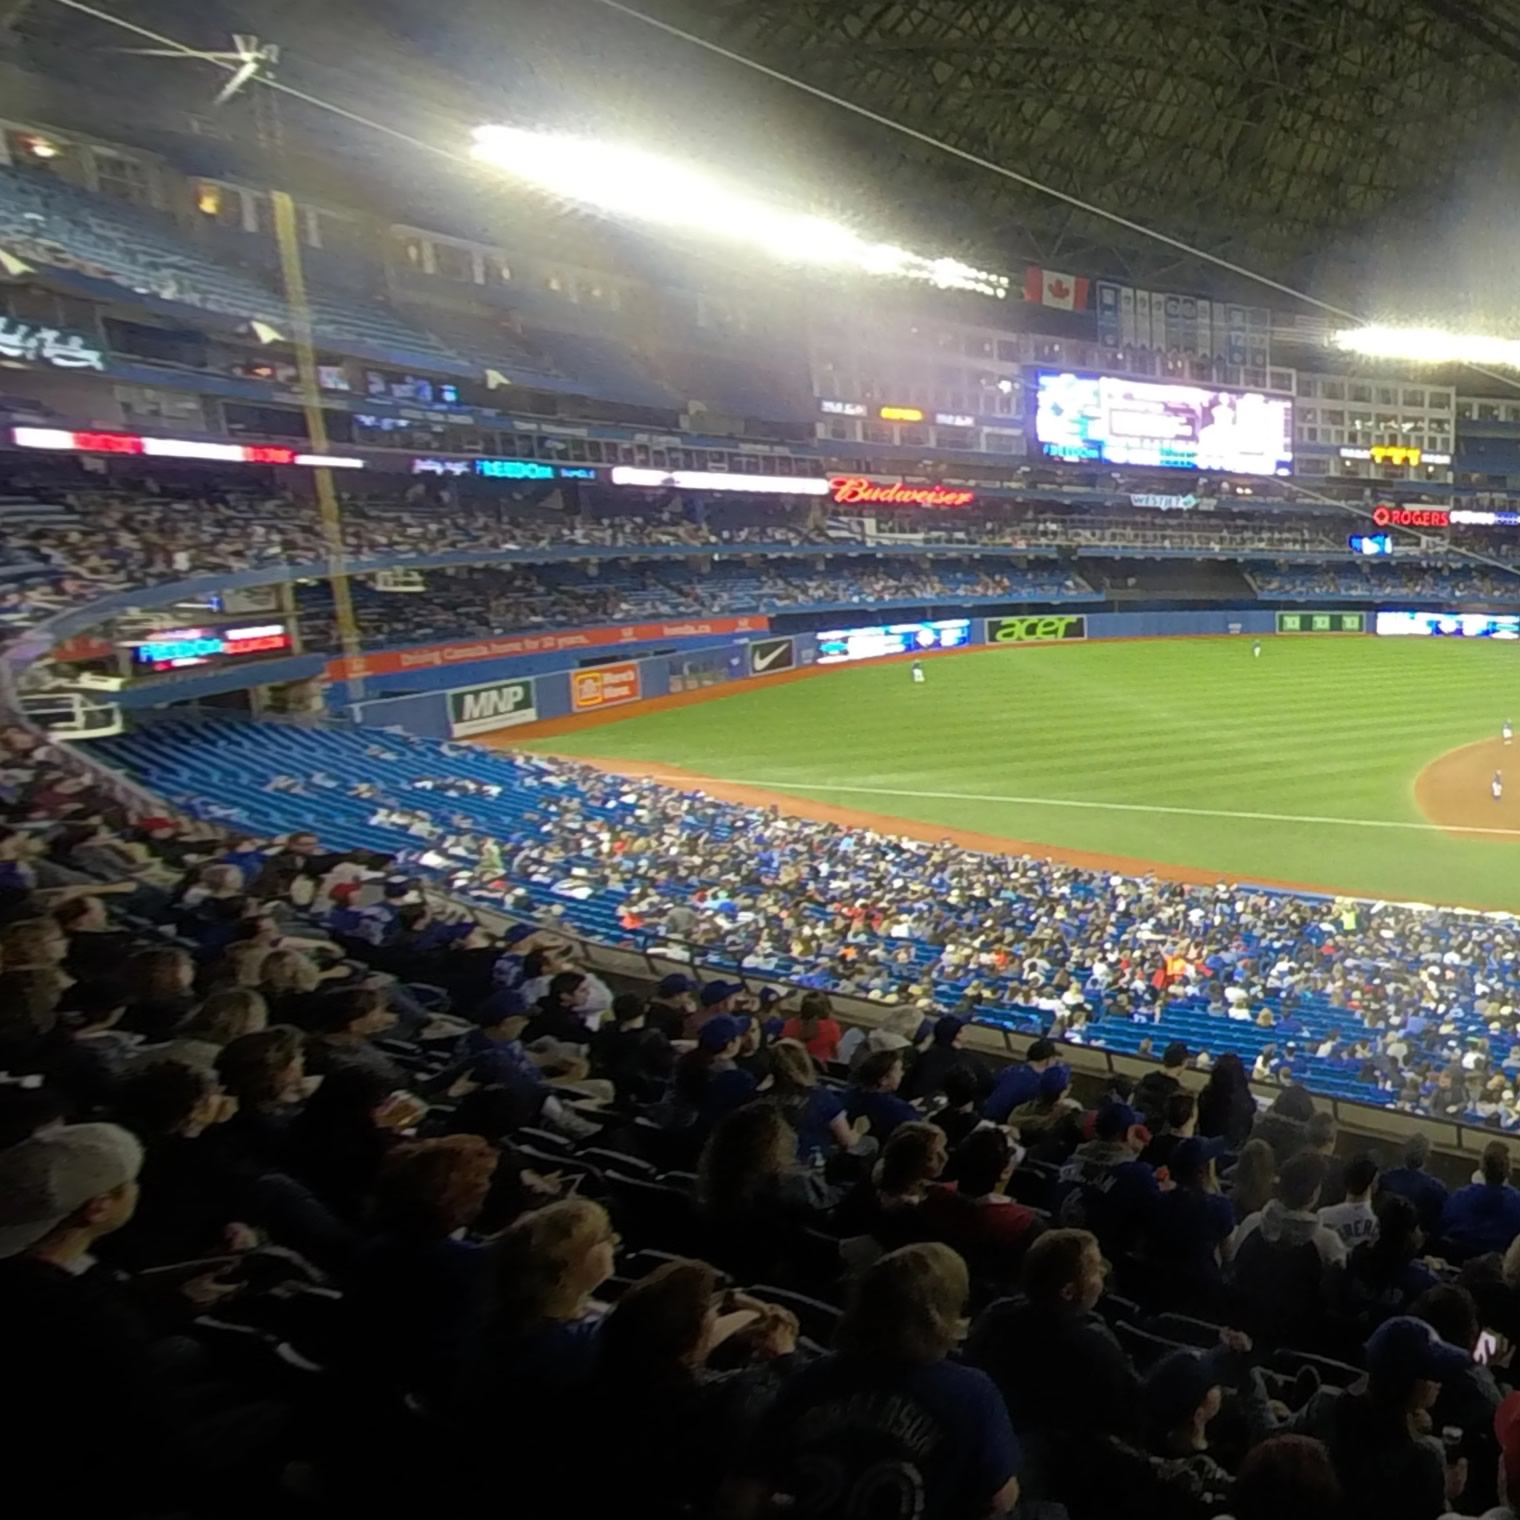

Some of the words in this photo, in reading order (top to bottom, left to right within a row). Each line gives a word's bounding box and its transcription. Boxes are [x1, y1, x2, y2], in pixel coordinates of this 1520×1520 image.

[829, 478, 974, 506] Budweiser
[1391, 510, 1449, 527] ROGERS
[996, 617, 1077, 641] acer
[462, 685, 524, 721] MNP
